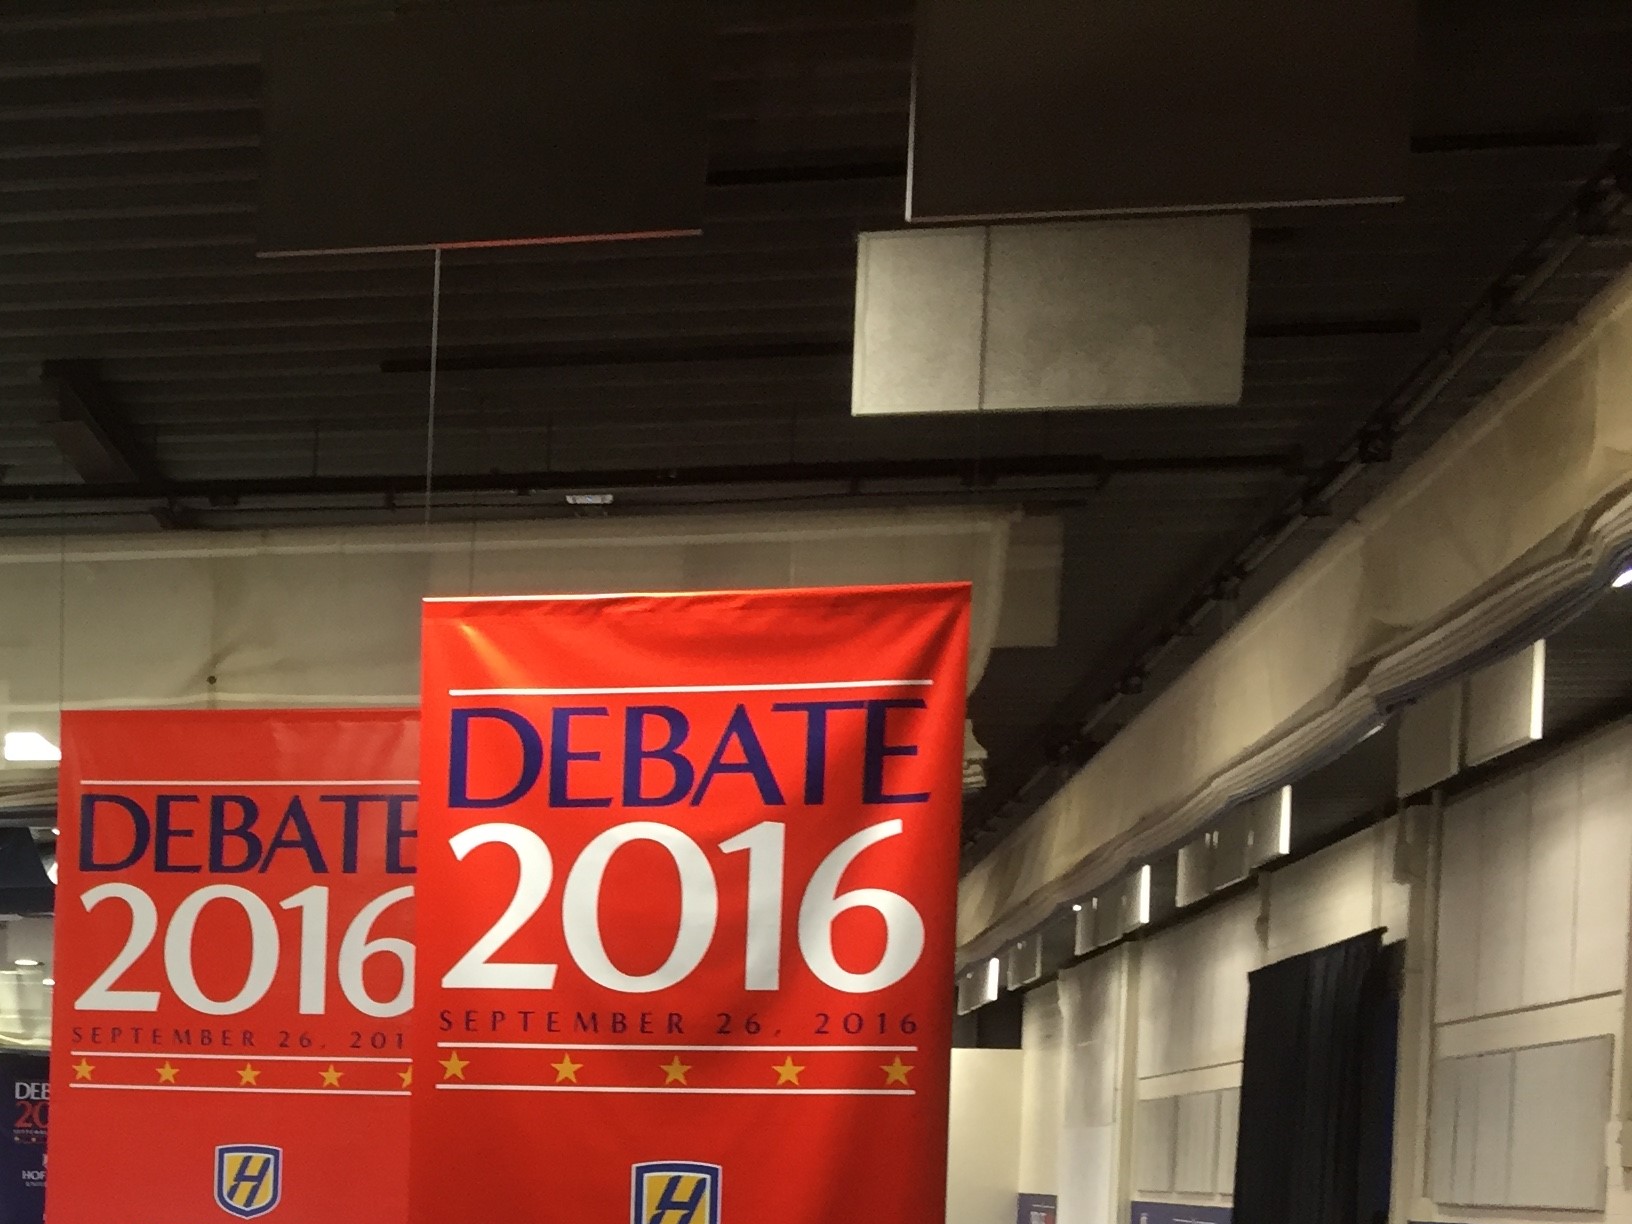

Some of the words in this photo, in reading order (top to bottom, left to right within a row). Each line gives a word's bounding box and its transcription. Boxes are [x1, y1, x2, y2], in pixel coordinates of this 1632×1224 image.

[448, 698, 930, 809] DEBATE
[78, 794, 418, 875] DEBATE
[441, 818, 926, 994] 2016
[73, 881, 416, 1018] 2016
[71, 1026, 255, 1047] SEPTEMBER
[278, 1029, 325, 1049] 26,
[349, 1031, 404, 1050] 201
[438, 1010, 685, 1035] SEPTEMBER
[716, 1012, 782, 1037] 26,
[814, 1012, 918, 1035] 2016
[14, 1082, 50, 1100] DEB
[14, 1100, 48, 1128] 20
